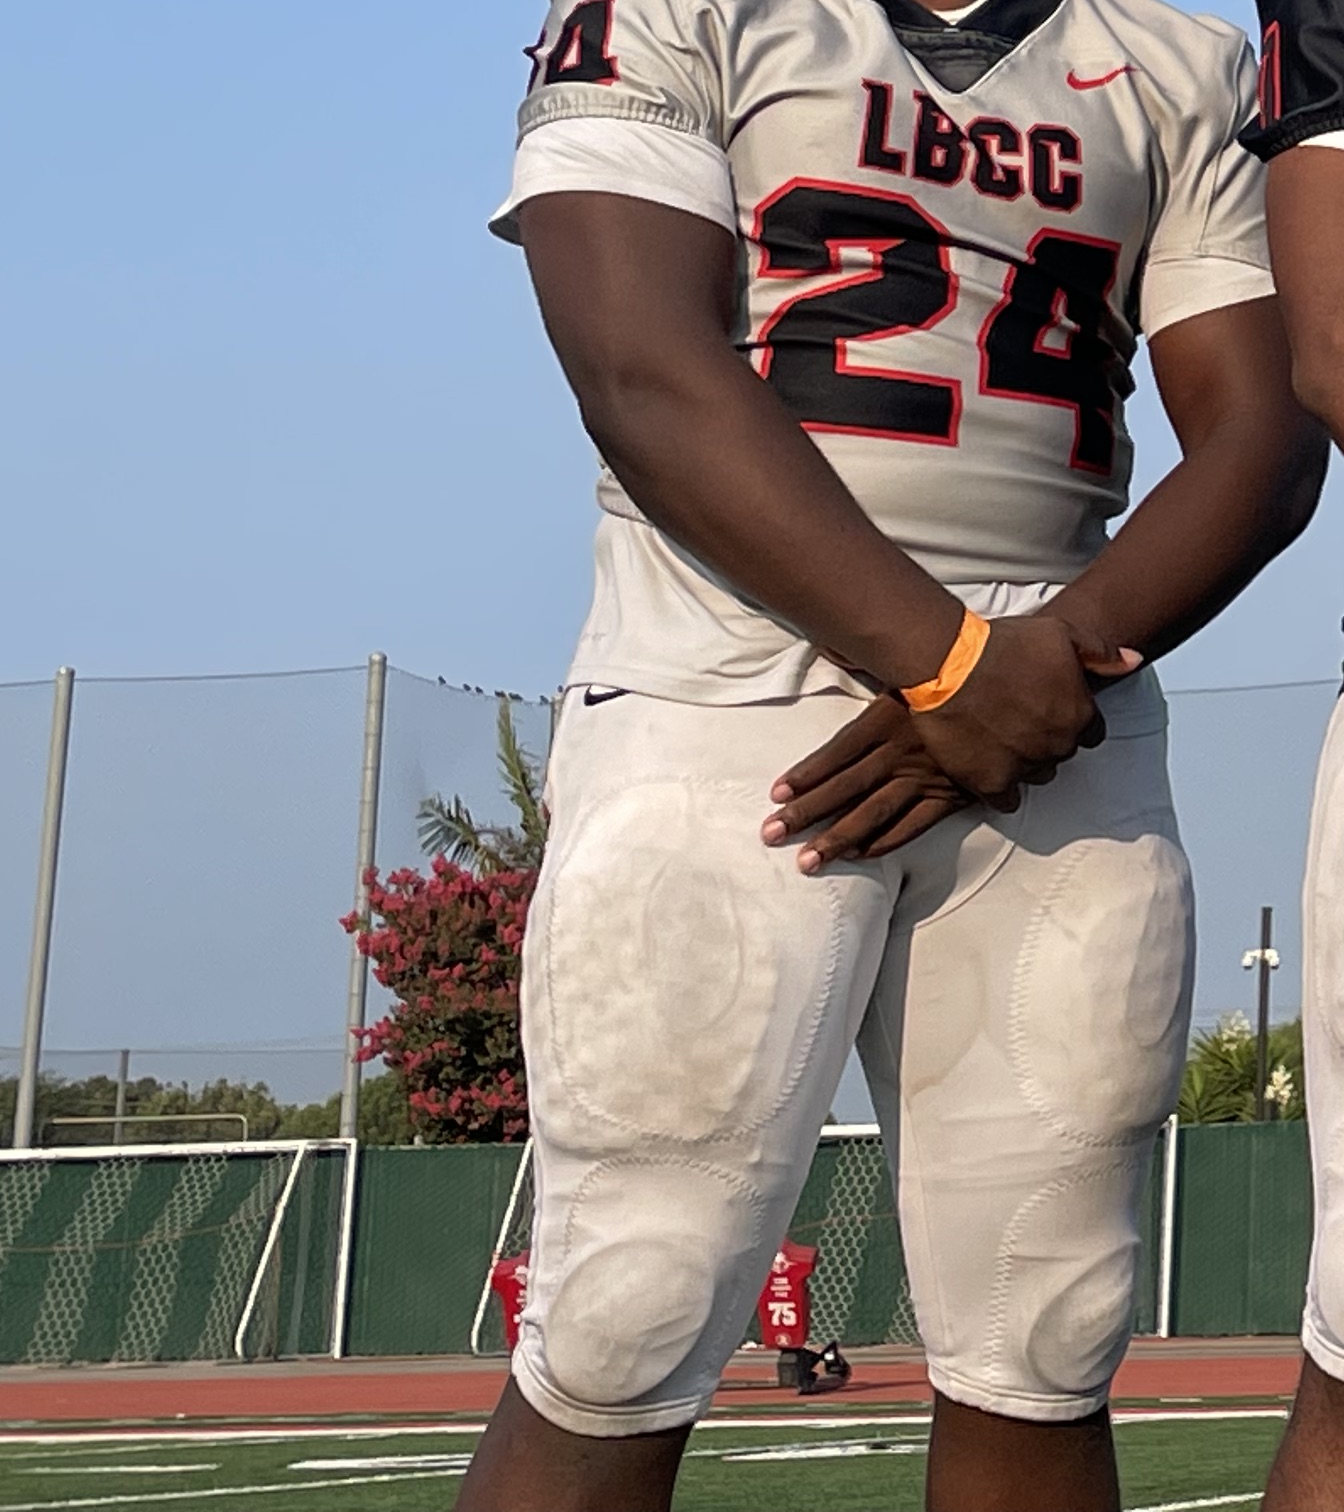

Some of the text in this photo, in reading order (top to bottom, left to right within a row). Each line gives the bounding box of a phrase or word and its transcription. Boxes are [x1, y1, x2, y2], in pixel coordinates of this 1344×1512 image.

[860, 78, 1083, 213] LBCC
[752, 176, 1122, 475] 24
[768, 1302, 797, 1326] 75
